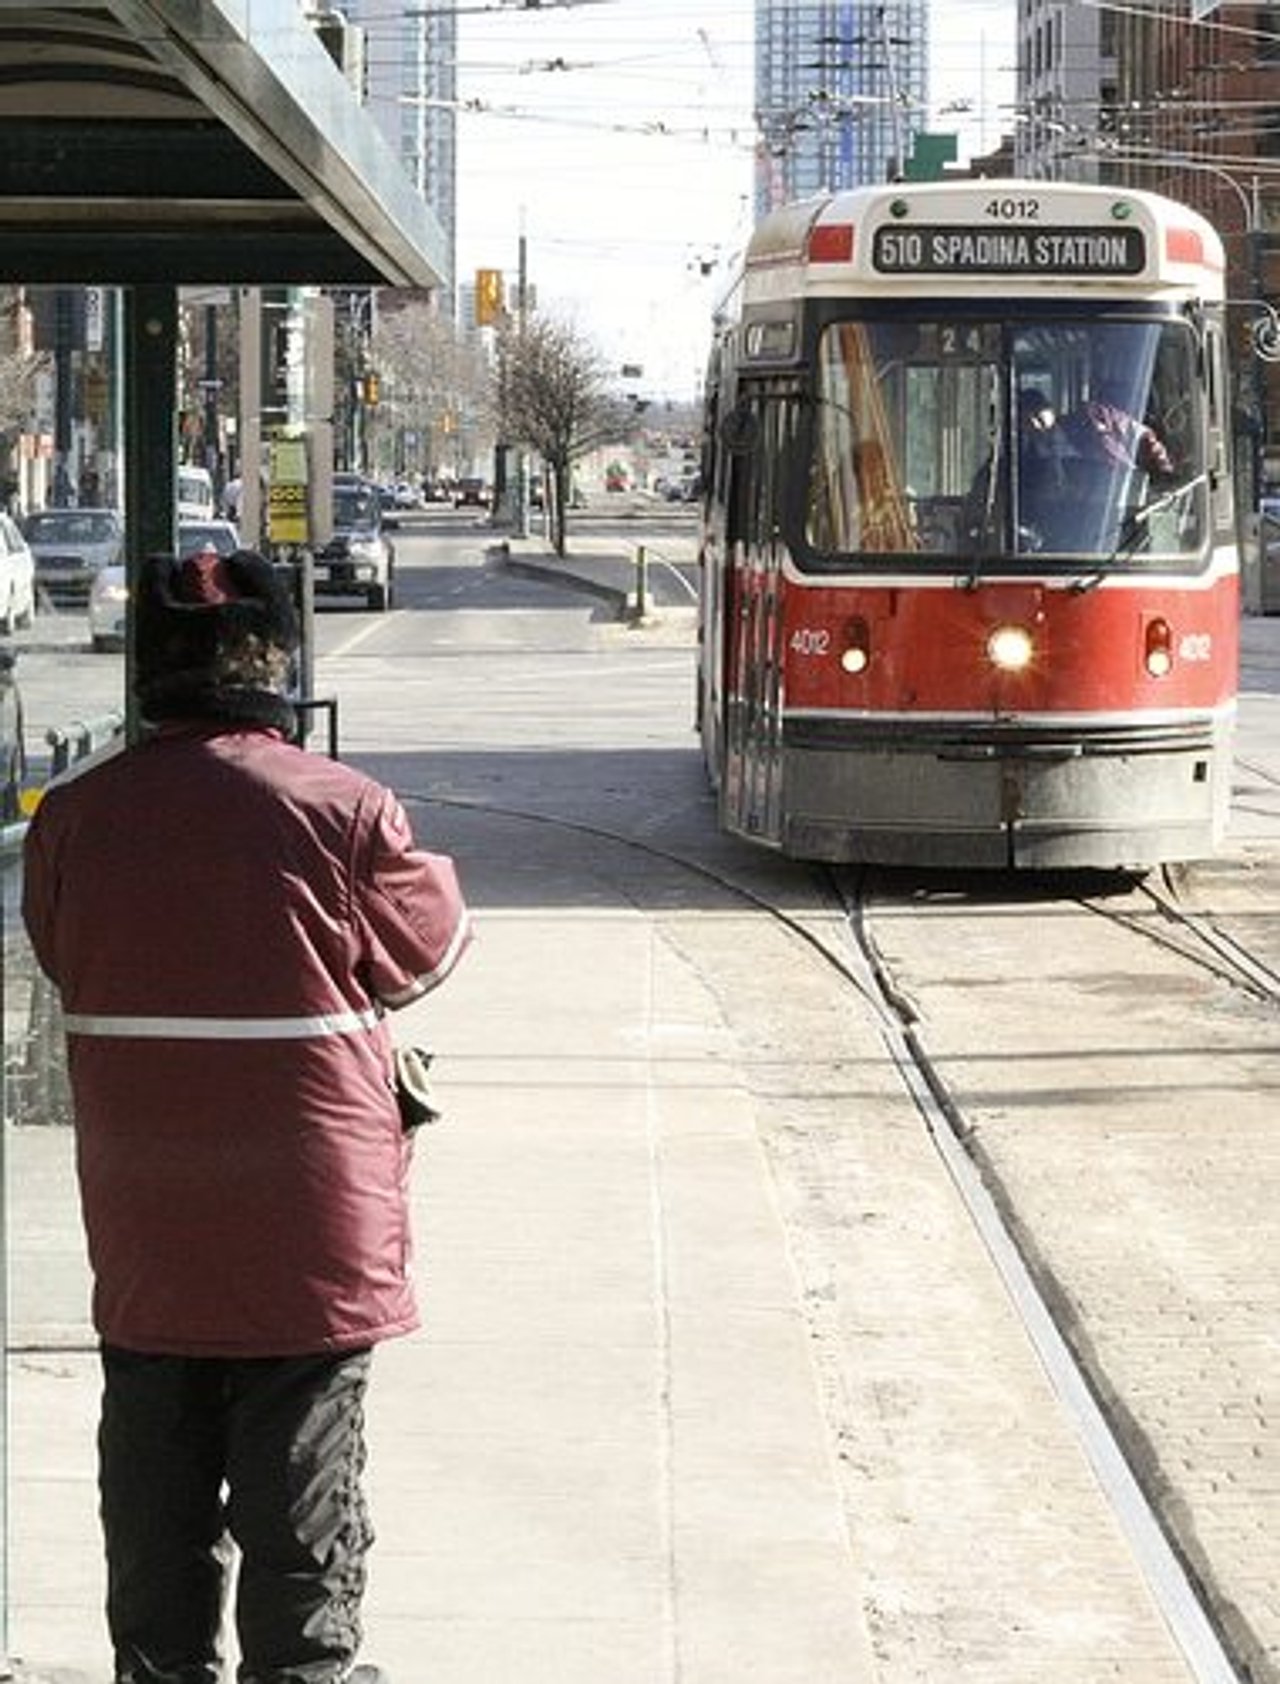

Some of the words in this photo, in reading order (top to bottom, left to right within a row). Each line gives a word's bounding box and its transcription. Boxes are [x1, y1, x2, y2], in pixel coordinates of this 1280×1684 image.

[985, 200, 1040, 218] 4012
[881, 234, 922, 265] 510
[932, 235, 1030, 266] SPADINA
[1035, 235, 1127, 266] STATION
